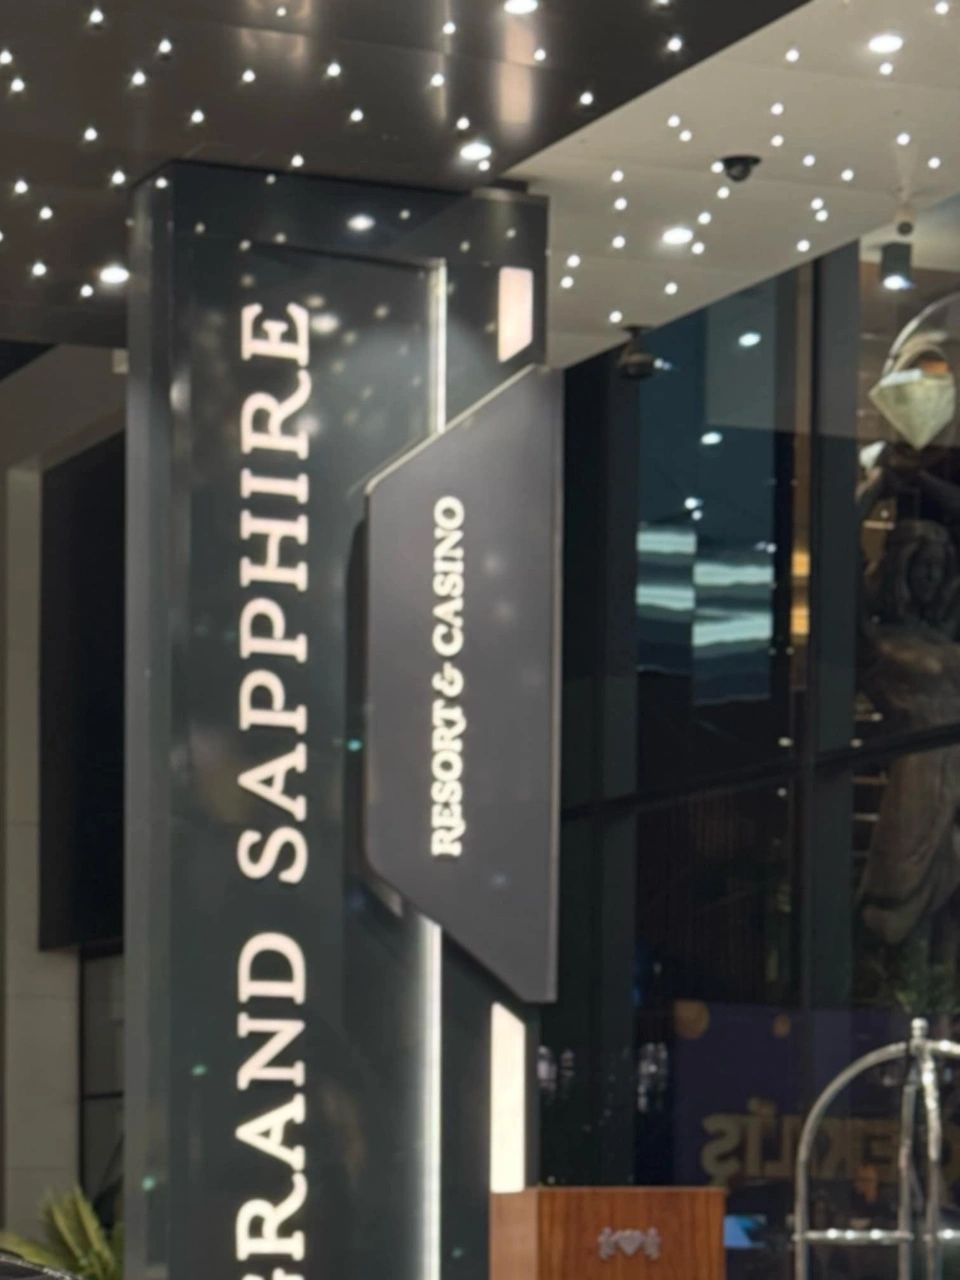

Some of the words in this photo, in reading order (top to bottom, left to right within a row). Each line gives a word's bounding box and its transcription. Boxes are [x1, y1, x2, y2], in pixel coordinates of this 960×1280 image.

[238, 302, 312, 885] SAPPHIRE
[432, 495, 465, 656] CASINO
[432, 662, 465, 698] &
[431, 699, 467, 857] RESORT
